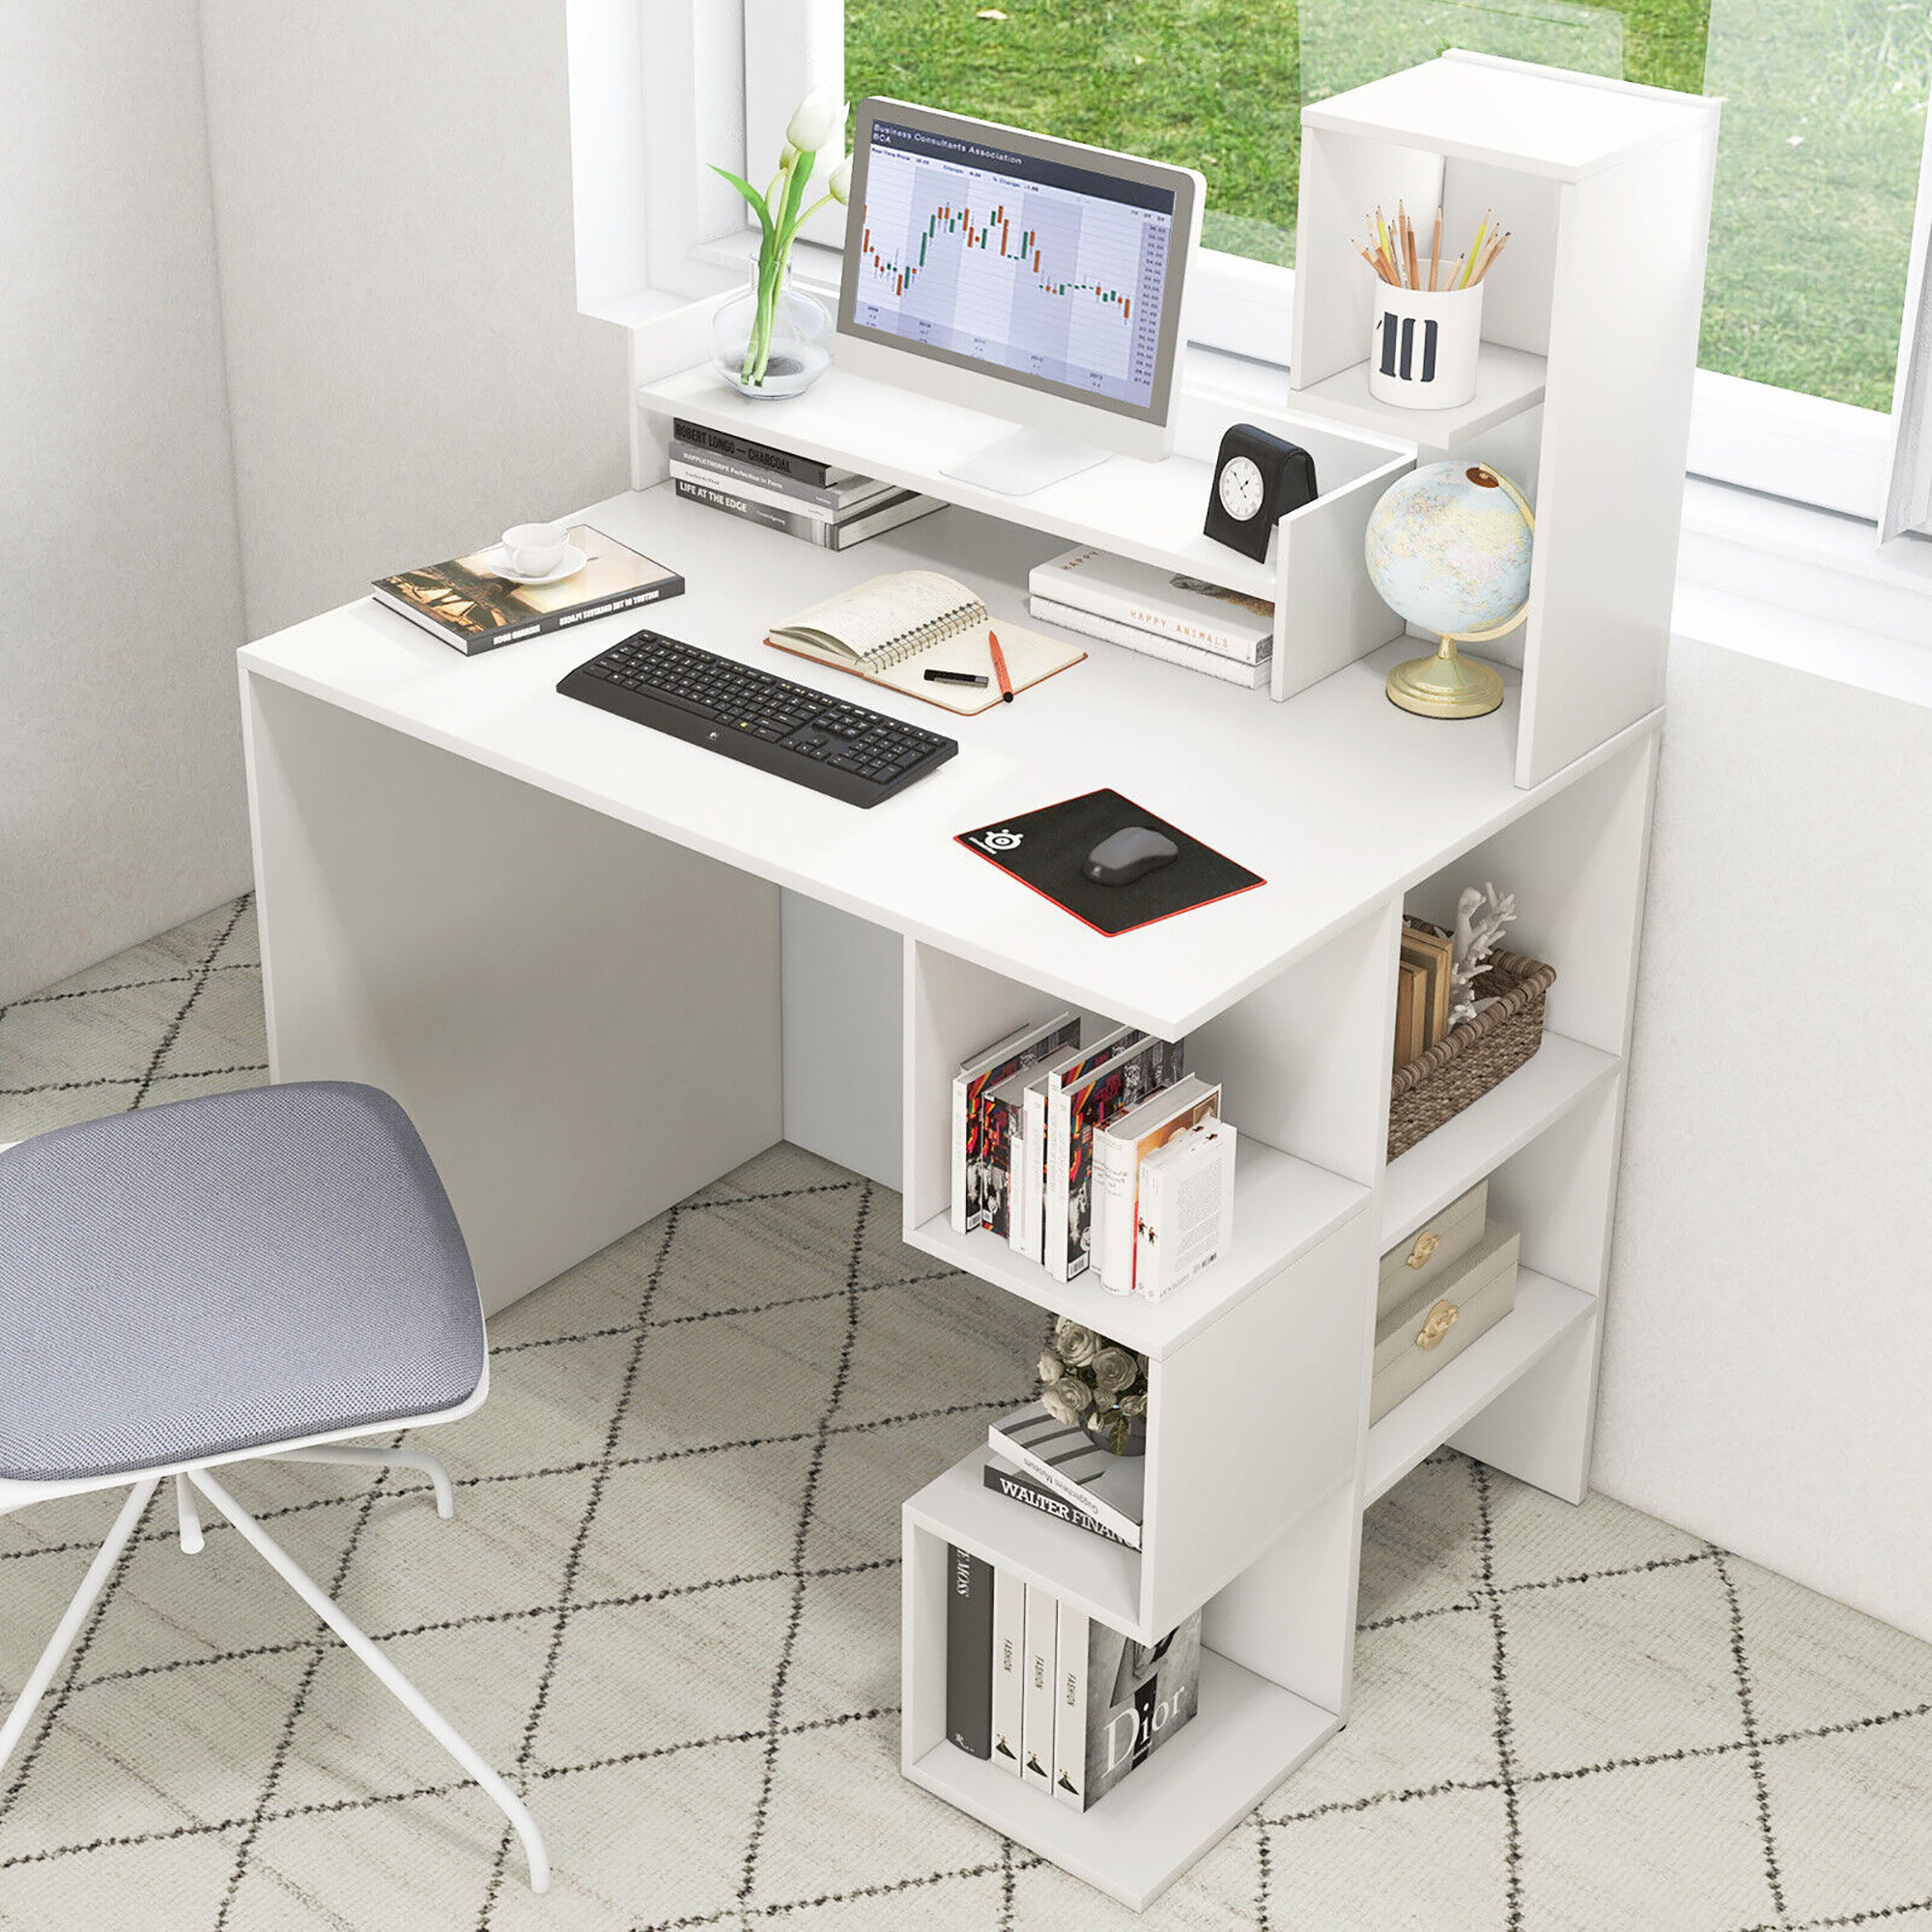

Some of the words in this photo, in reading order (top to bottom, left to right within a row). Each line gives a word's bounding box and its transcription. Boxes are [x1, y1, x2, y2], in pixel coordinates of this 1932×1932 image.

[873, 123, 912, 140] Business
[914, 133, 966, 153] Consultants
[968, 146, 1023, 165] Association
[676, 424, 707, 443] ROBERT
[748, 447, 792, 473] CHARCOAL
[679, 481, 696, 495] LIFE
[697, 488, 707, 498] AT
[709, 491, 724, 505] THE
[725, 498, 748, 513] EDGE
[1060, 550, 1099, 571] HAPPY
[1129, 610, 1167, 628] HAPPY
[1176, 623, 1229, 649] ANIMALS
[1022, 1457, 1054, 1485] Museum
[1000, 1477, 1070, 1521] WALTER
[1003, 1638, 1012, 1674] FASHION
[1035, 1655, 1044, 1690] FASHION
[1066, 1672, 1076, 1709] FASHION
[1100, 1686, 1185, 1779] Dior
